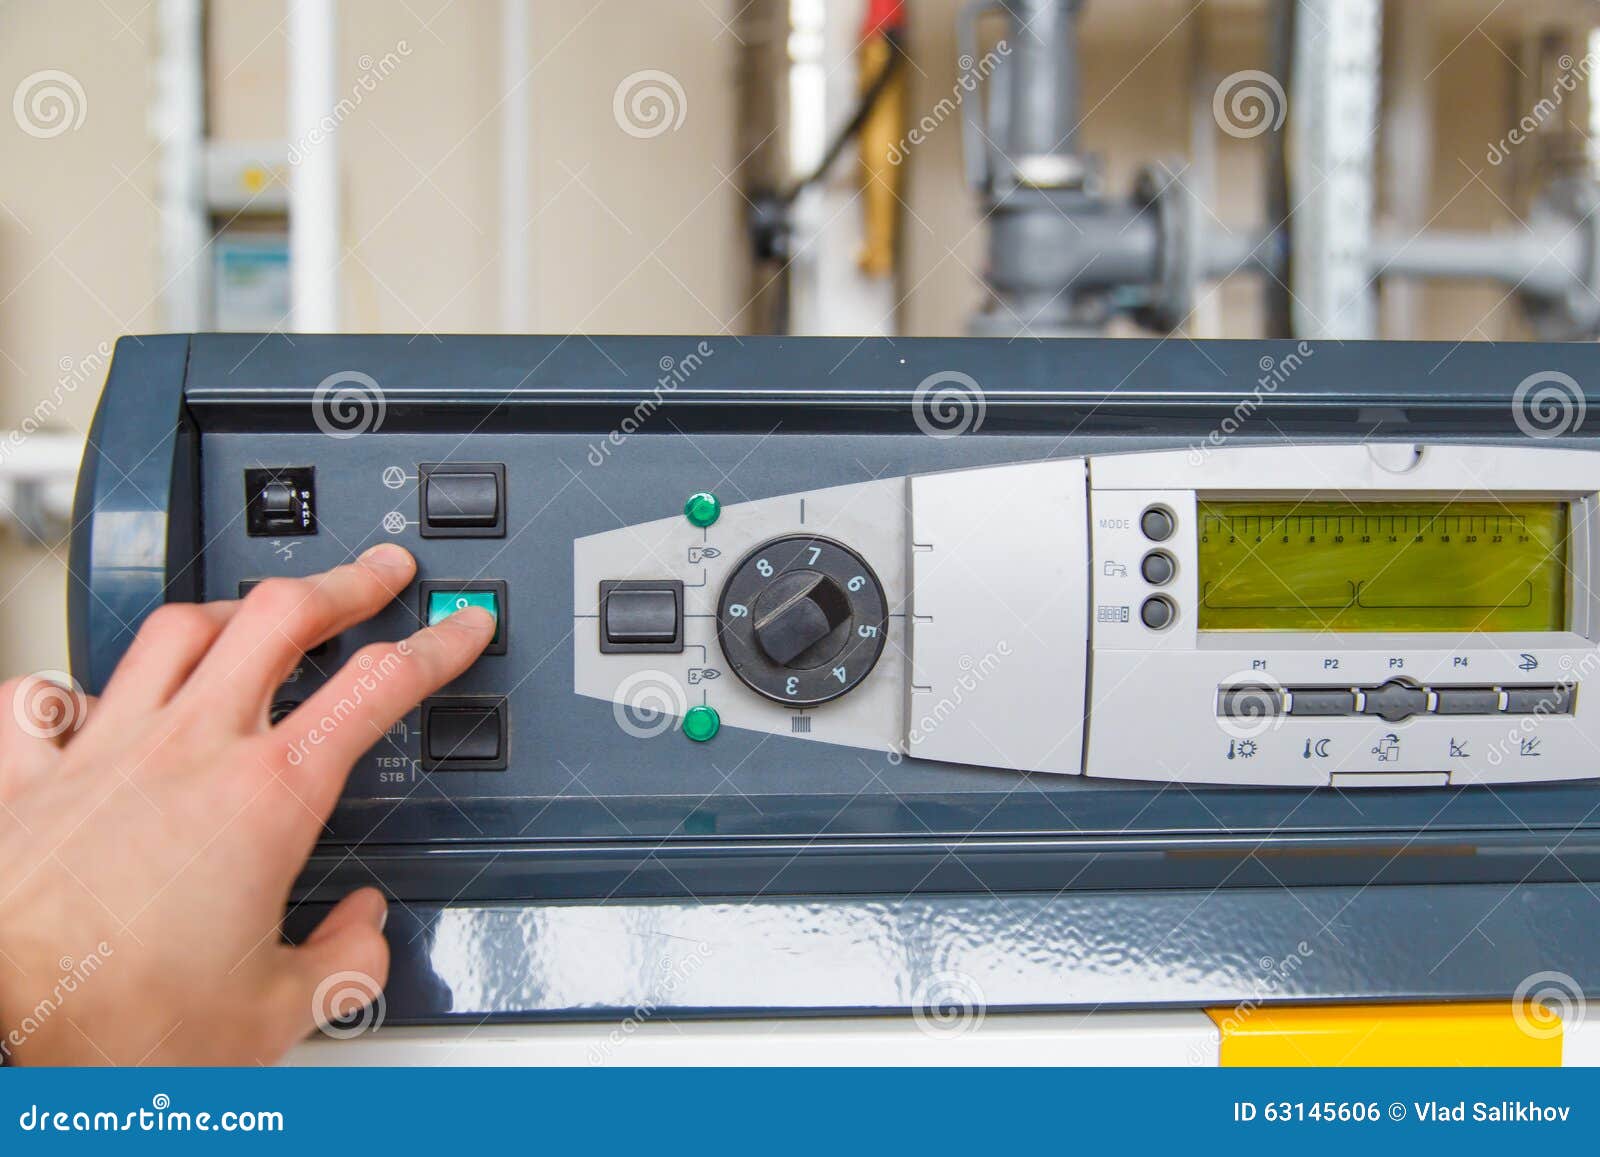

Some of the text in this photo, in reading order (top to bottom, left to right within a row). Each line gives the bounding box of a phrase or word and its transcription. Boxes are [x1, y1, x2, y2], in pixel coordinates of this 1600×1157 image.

[1099, 519, 1130, 529] MODE
[808, 547, 822, 565] 7
[756, 559, 774, 577] 8
[847, 575, 866, 592] 6
[858, 625, 877, 638] 5
[1252, 657, 1468, 670] P1 P2 P3 P4
[832, 666, 847, 684] 4
[786, 676, 800, 695] 3
[376, 757, 409, 768] TEST
[379, 772, 405, 783] STB
